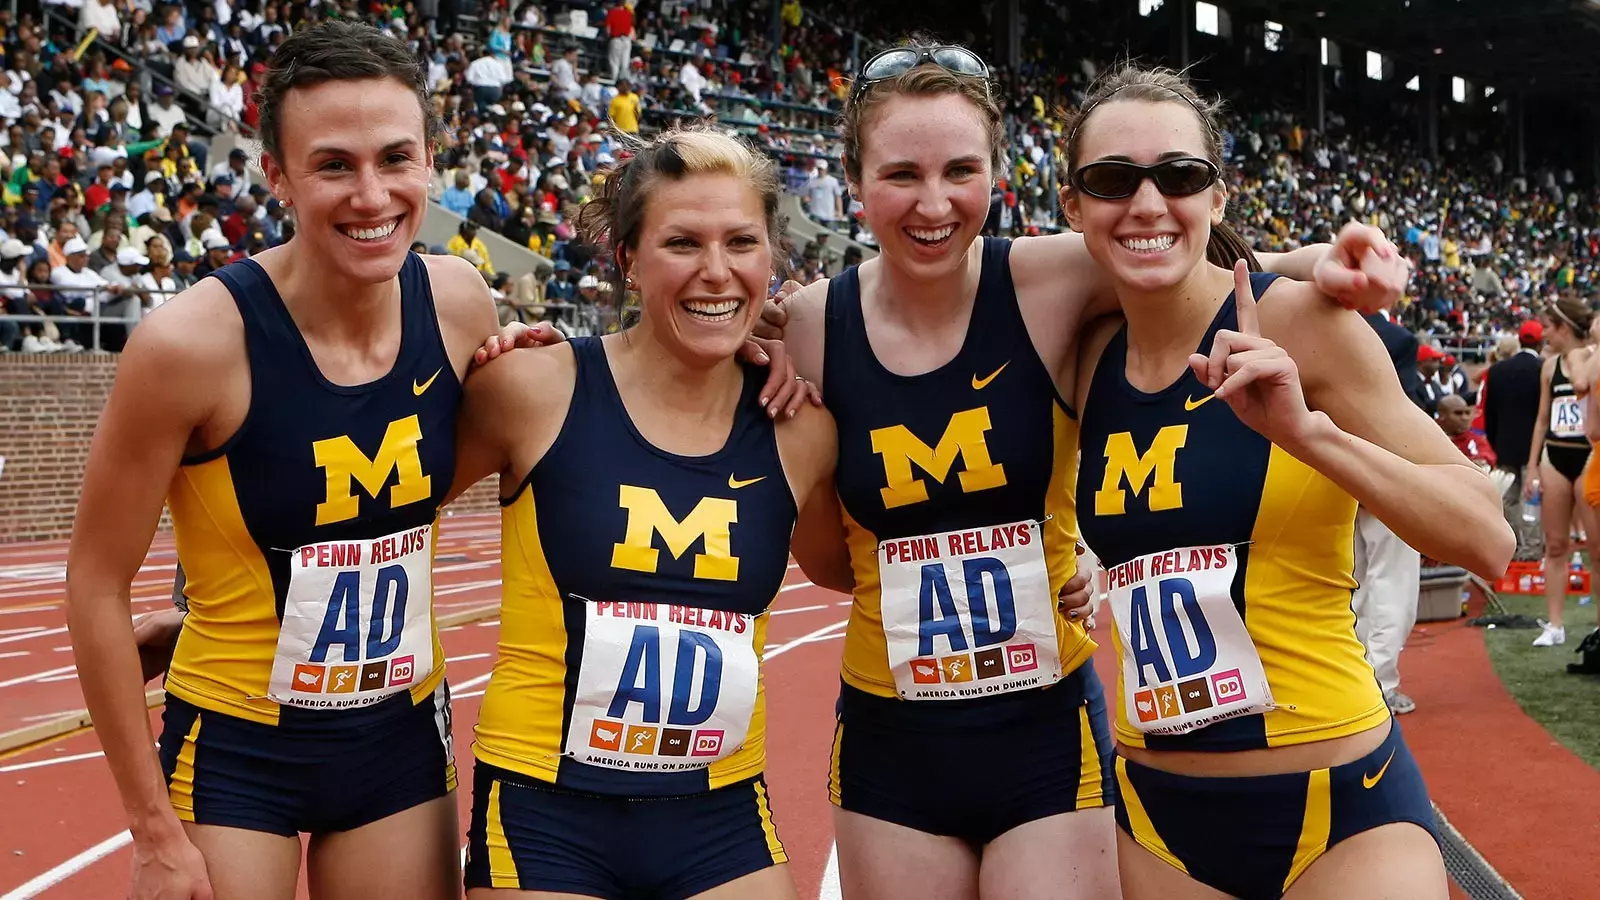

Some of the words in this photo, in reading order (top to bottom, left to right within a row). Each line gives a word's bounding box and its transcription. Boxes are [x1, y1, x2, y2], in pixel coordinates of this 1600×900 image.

[1558, 403, 1579, 424] AS
[312, 414, 431, 526] M
[870, 406, 1008, 509] M
[1095, 424, 1189, 516] M
[301, 543, 361, 567] PENN
[370, 529, 425, 564] RELAYS
[610, 484, 740, 581] M
[885, 537, 940, 565] PENN
[948, 523, 1031, 557] RELAYS
[1108, 559, 1144, 590] PENN
[1151, 547, 1228, 577] RELAYS
[308, 564, 409, 662] AD
[596, 600, 657, 620] PENN
[668, 603, 746, 634] RELAYS
[918, 557, 1017, 656] AD
[1131, 577, 1217, 688] AD
[368, 671, 378, 679] ON
[394, 666, 410, 678] DD
[606, 625, 723, 725] AD
[983, 659, 995, 667] ON
[1013, 652, 1031, 664] DD
[289, 697, 333, 707] AMERICA
[336, 698, 359, 707] RUNS
[916, 690, 956, 698] AMERICA
[959, 687, 983, 696] RUNS
[986, 684, 1000, 693] ON
[1188, 690, 1200, 698] ON
[1219, 680, 1238, 694] DD
[1195, 717, 1210, 726] ON
[586, 755, 630, 768] AMERICA
[634, 762, 659, 770] RUNS
[699, 739, 716, 749] DD
